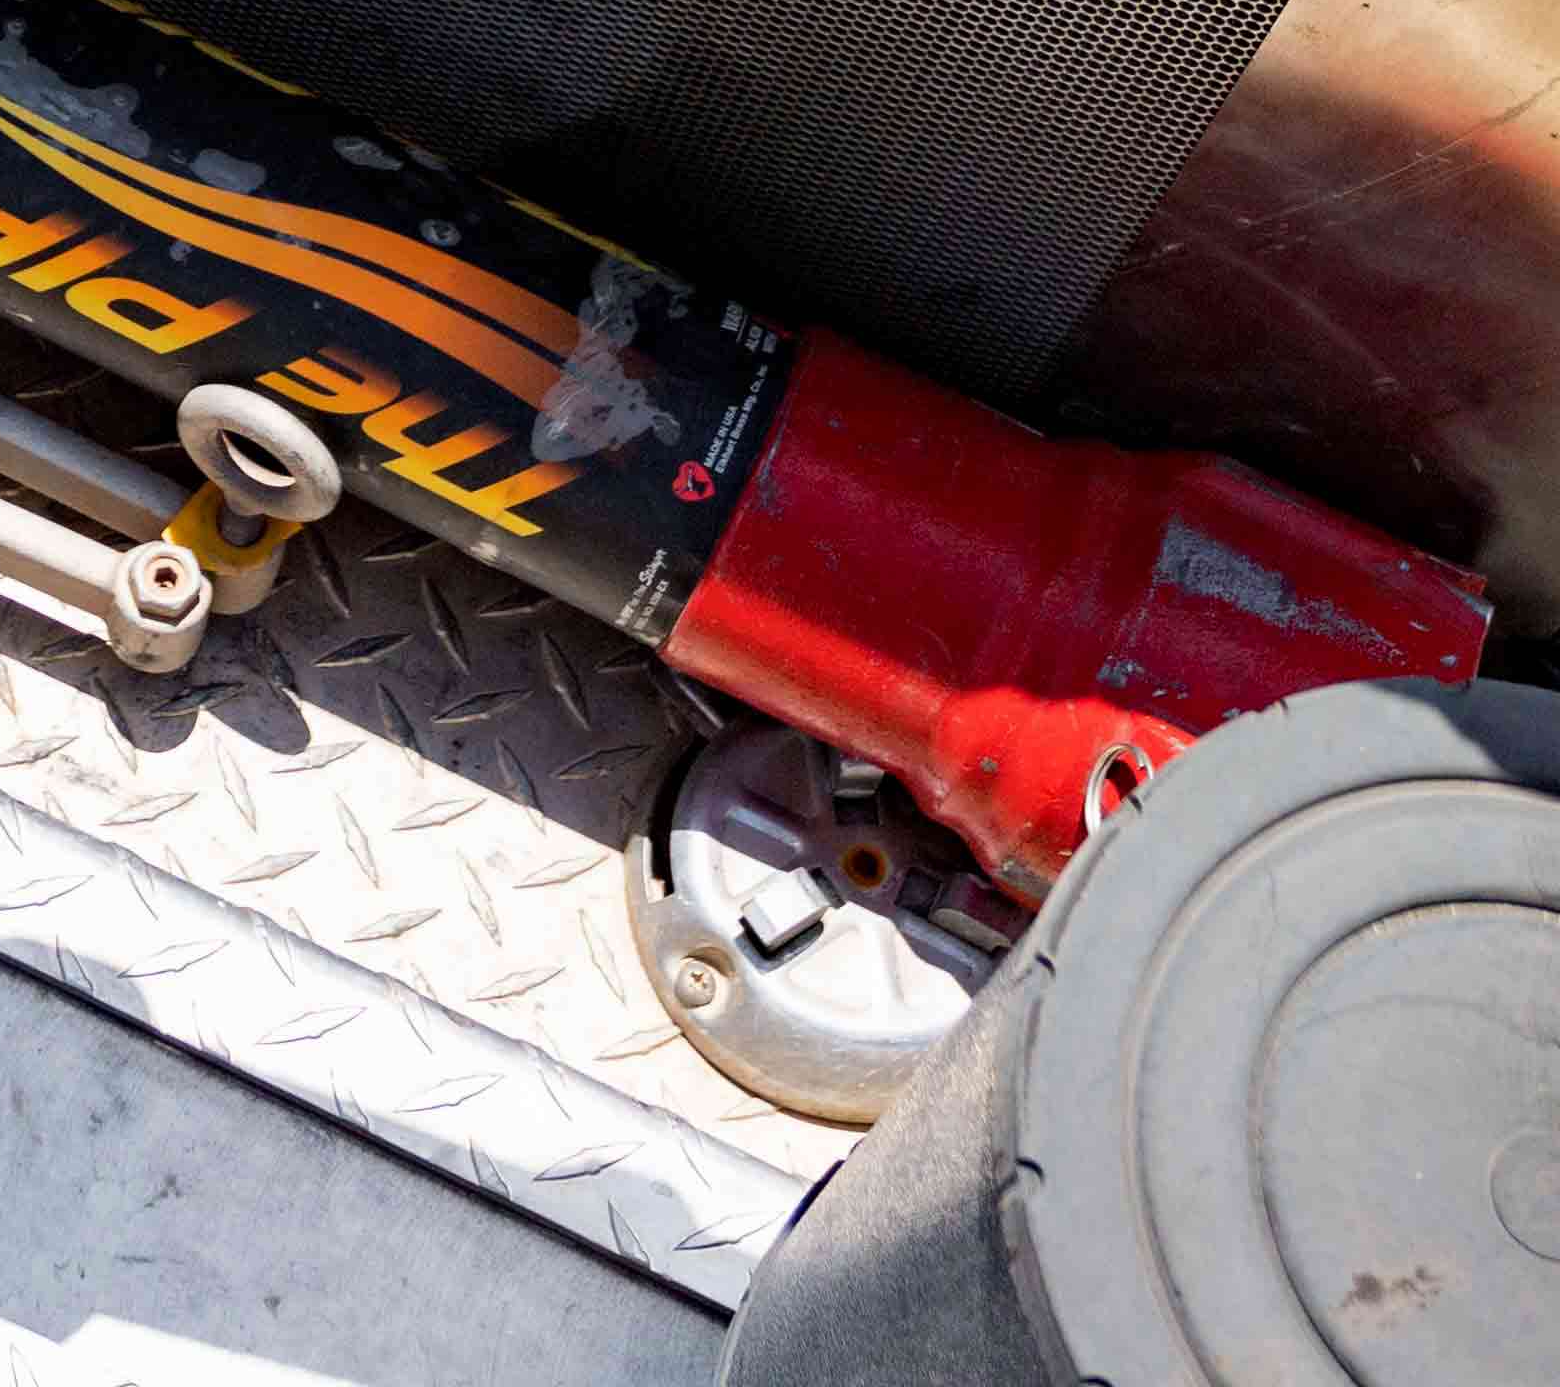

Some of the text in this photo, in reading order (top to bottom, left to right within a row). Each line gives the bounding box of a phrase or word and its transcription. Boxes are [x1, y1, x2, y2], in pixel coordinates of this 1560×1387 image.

[703, 405, 739, 469] MADE IN USA
